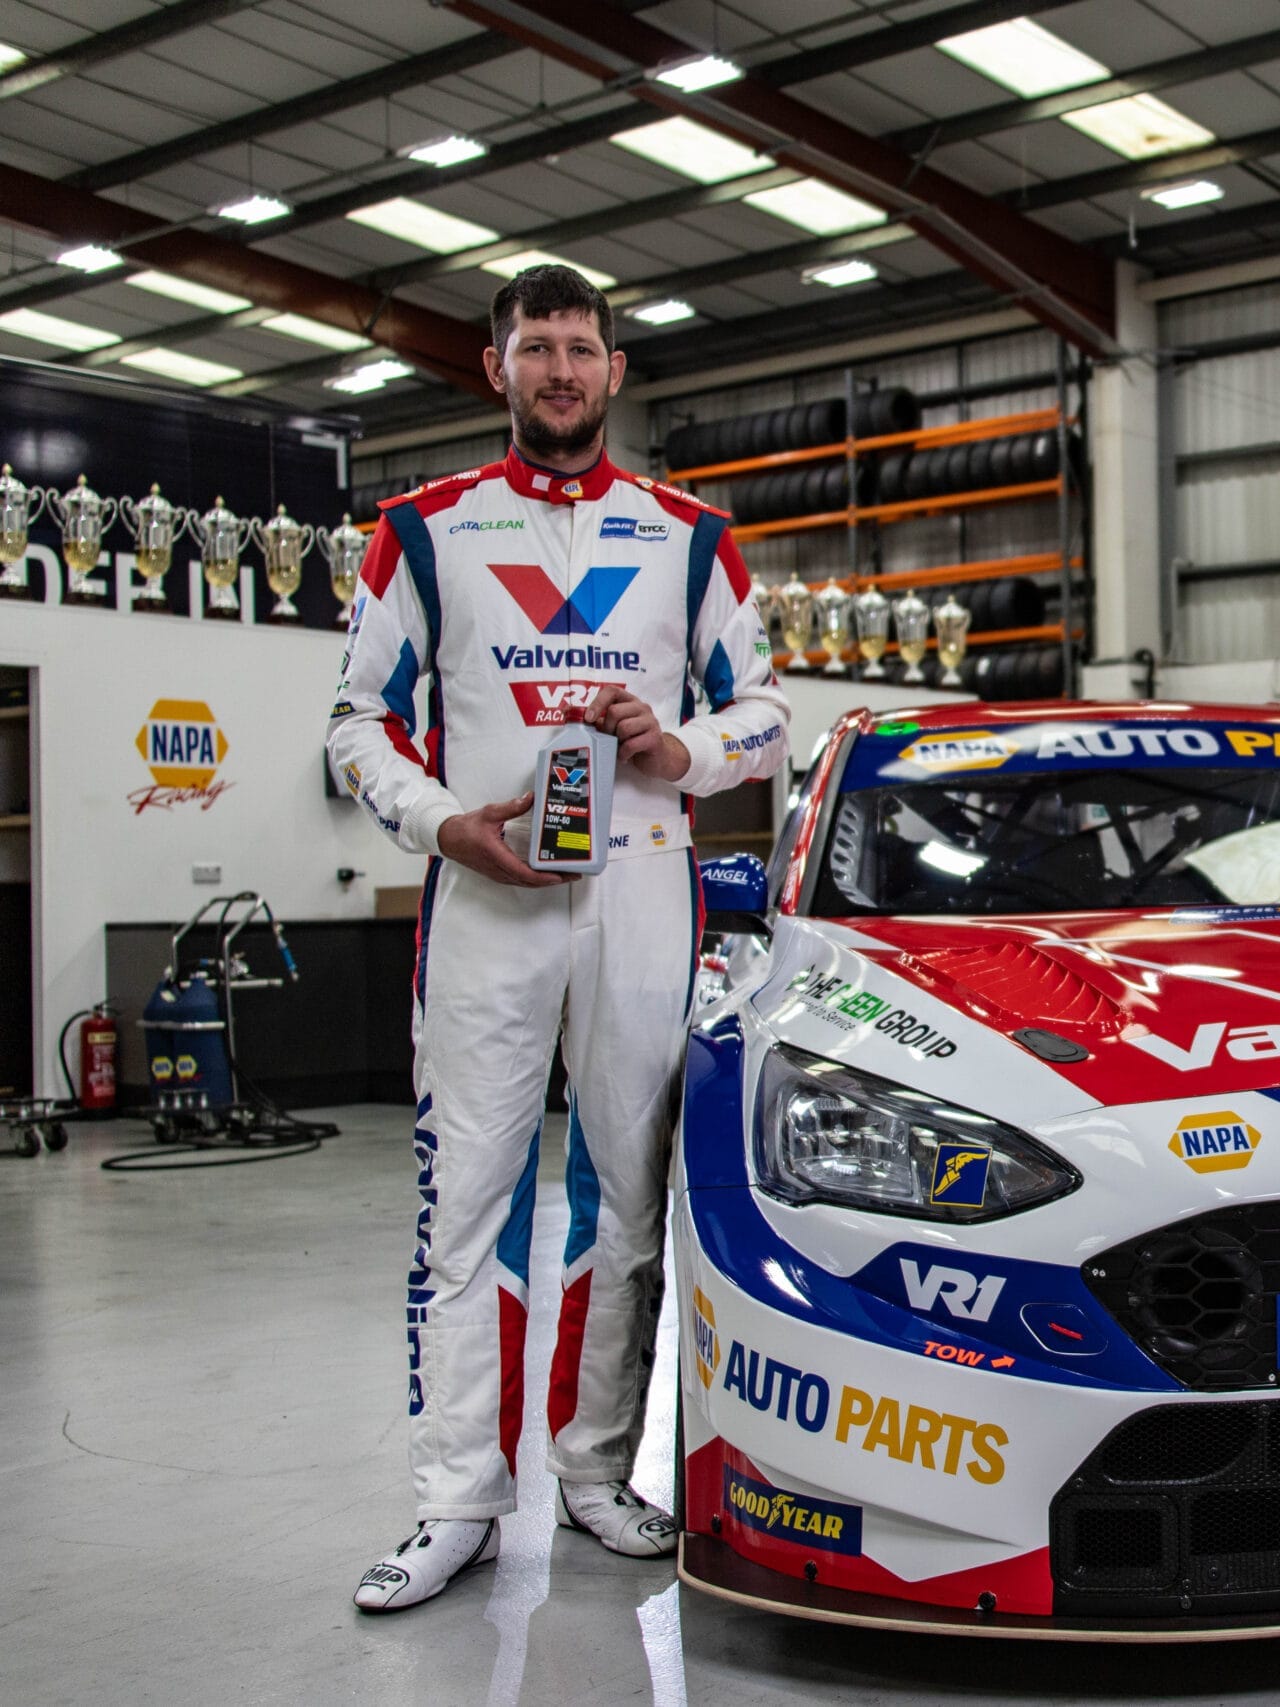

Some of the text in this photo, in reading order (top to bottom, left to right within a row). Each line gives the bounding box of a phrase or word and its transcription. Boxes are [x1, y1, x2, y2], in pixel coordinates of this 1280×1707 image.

[449, 519, 525, 535] CATACLEAN
[491, 644, 641, 671] Valvoline
[152, 724, 215, 764] NAPA
[916, 740, 1006, 761] NAPA
[1036, 728, 1221, 759] AUTO
[547, 803, 569, 814] VR1
[1181, 1127, 1250, 1158] NAPA
[898, 1257, 1008, 1323] VR1
[923, 1340, 986, 1367] TOW
[722, 1340, 831, 1434] AUTO
[834, 1384, 1011, 1486] PARTS
